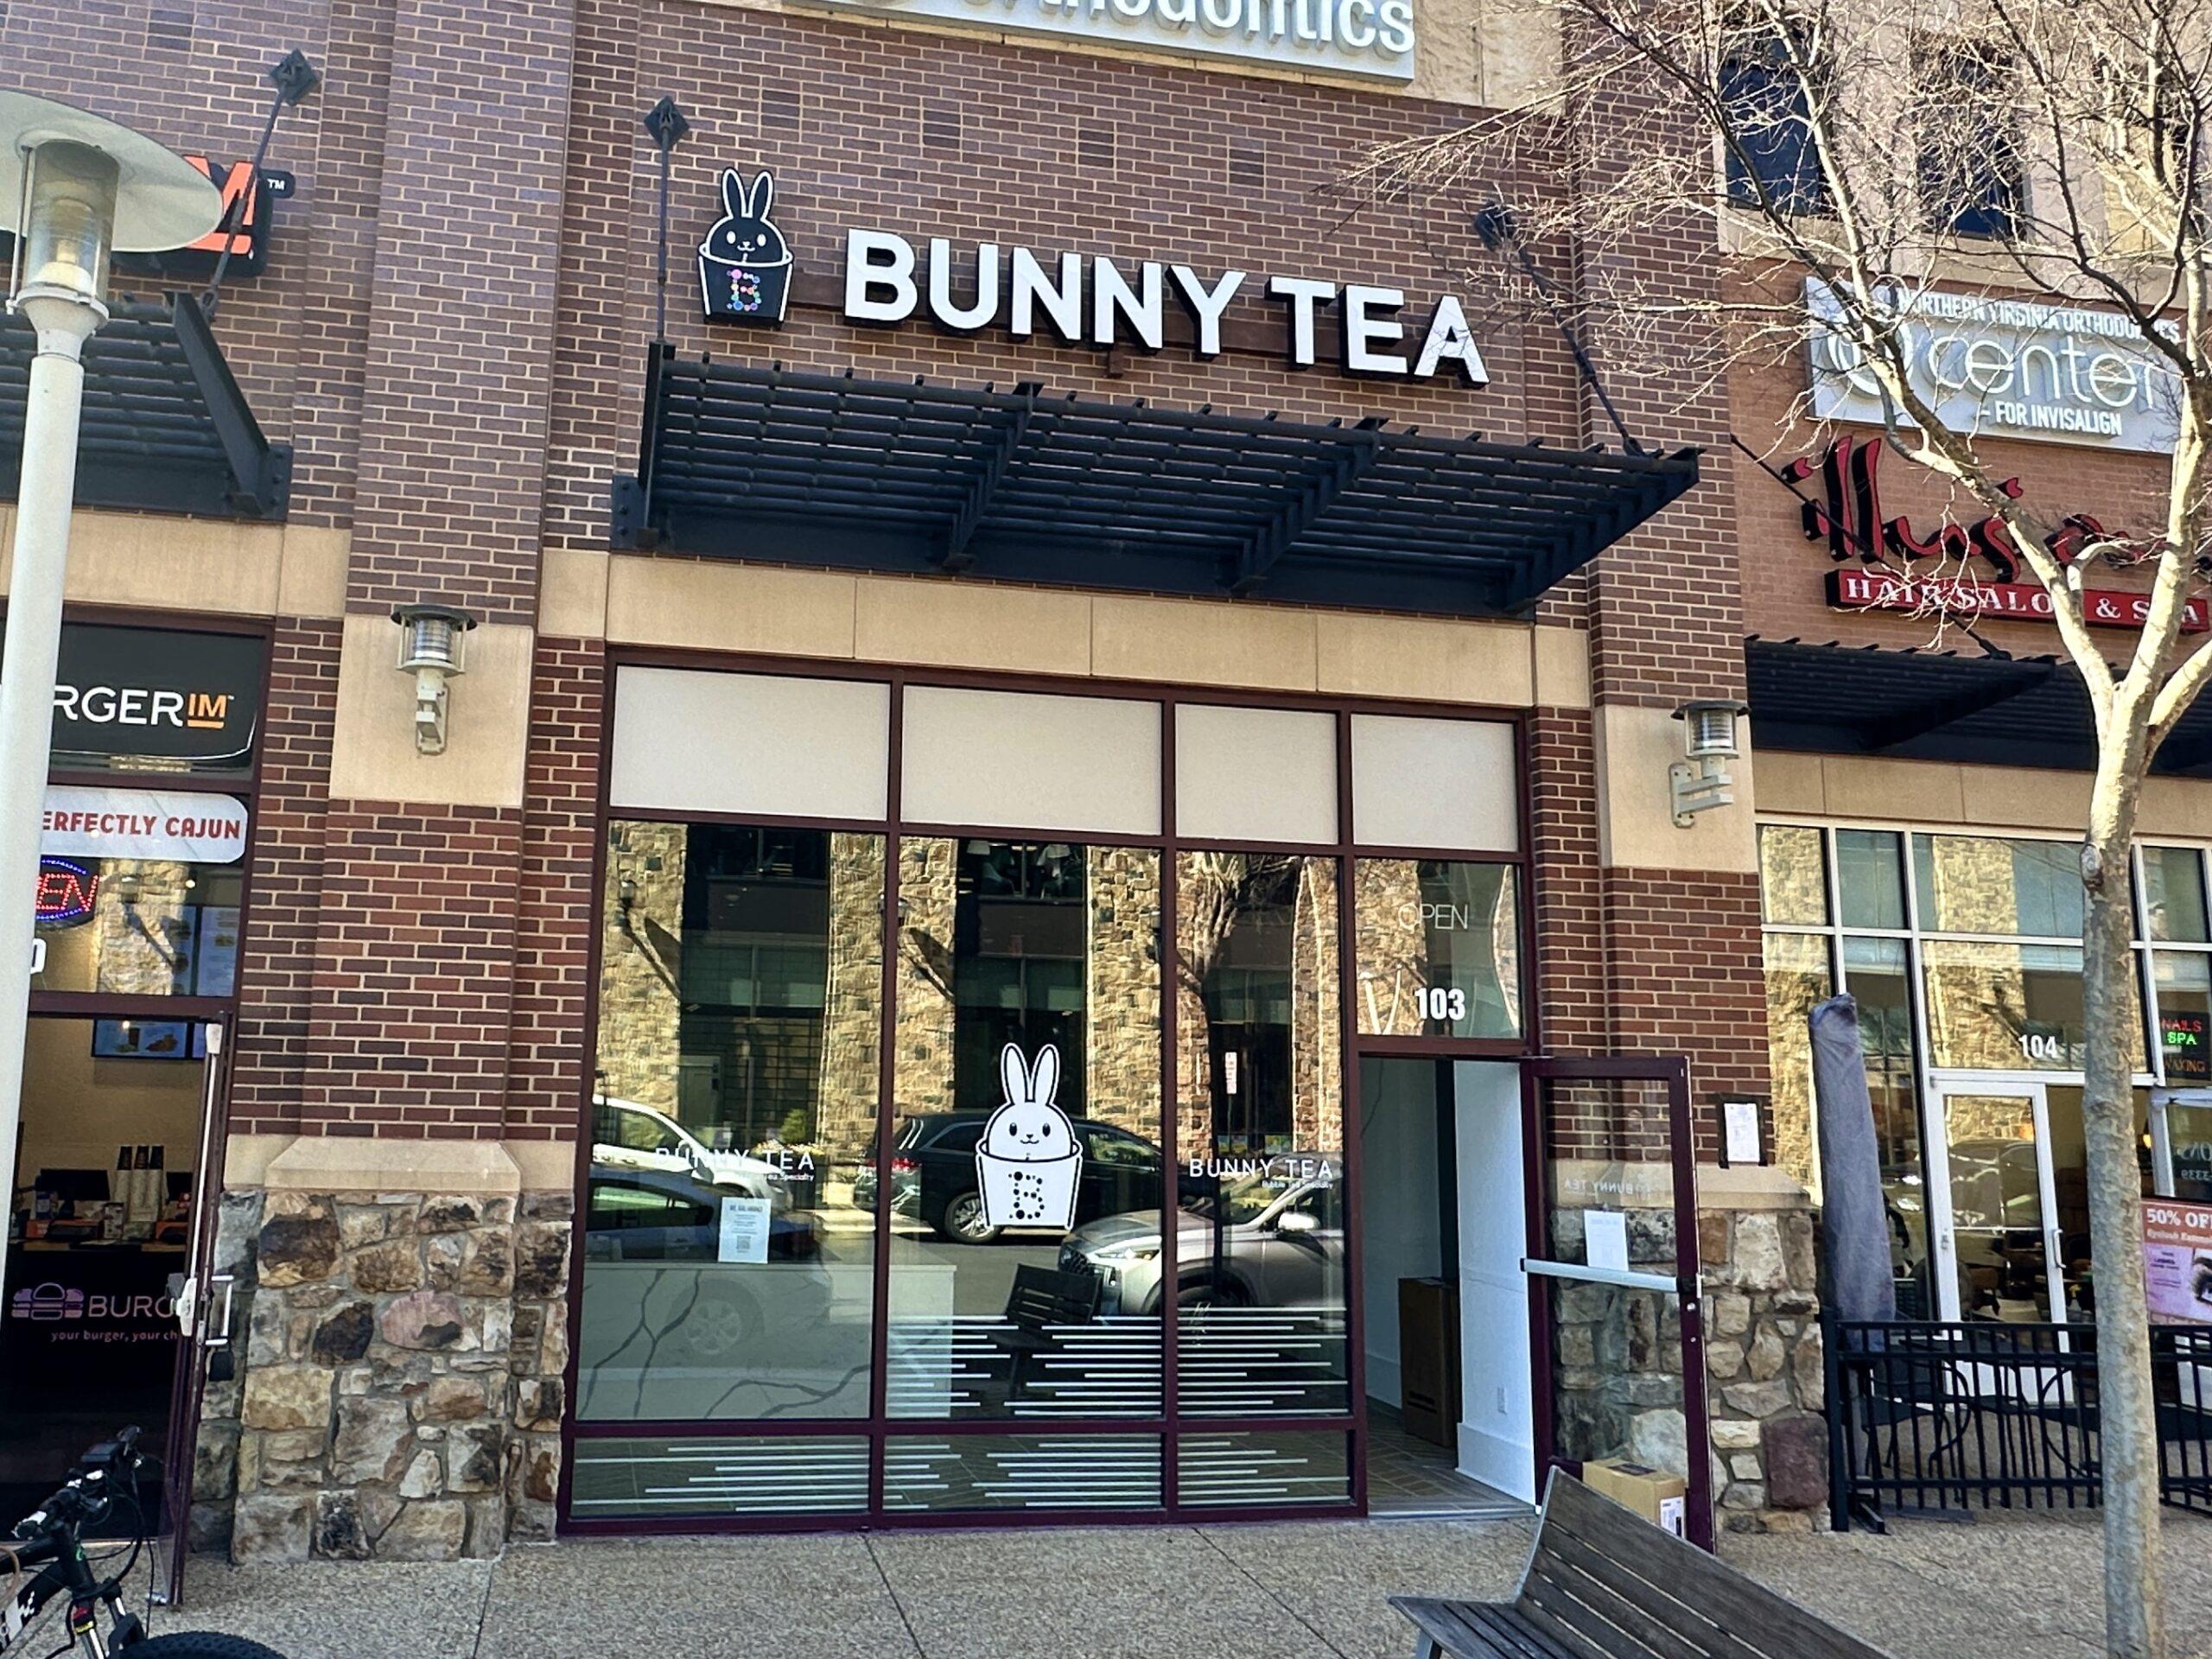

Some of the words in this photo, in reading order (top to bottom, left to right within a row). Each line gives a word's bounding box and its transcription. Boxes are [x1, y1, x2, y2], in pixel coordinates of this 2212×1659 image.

[844, 229, 1246, 356] BUNNY
[1270, 275, 1490, 386] TEA
[1995, 403, 2027, 427] FOR
[2031, 408, 2123, 435] INVISALIGN
[1846, 577, 1946, 610] HAIR
[1955, 586, 2055, 614] SALO
[2095, 598, 2121, 620] &
[2132, 600, 2199, 623] SA
[54, 684, 226, 729] RGERIM
[43, 810, 157, 836] ERFECTLY
[165, 817, 241, 840] CAJUN
[1398, 903, 1469, 931] OPEN
[1414, 988, 1465, 1020] 103
[2161, 1018, 2202, 1033] NAILS
[2018, 1034, 2058, 1058] 104
[2167, 1032, 2197, 1046] SPA
[764, 1149, 815, 1171] TEA
[1189, 1158, 1274, 1179] BUNNY
[1285, 1159, 1333, 1179] TEA
[2146, 1209, 2182, 1227] 50%
[52, 1332, 79, 1342] your
[84, 1330, 129, 1343] burger,
[132, 1331, 161, 1342] your
